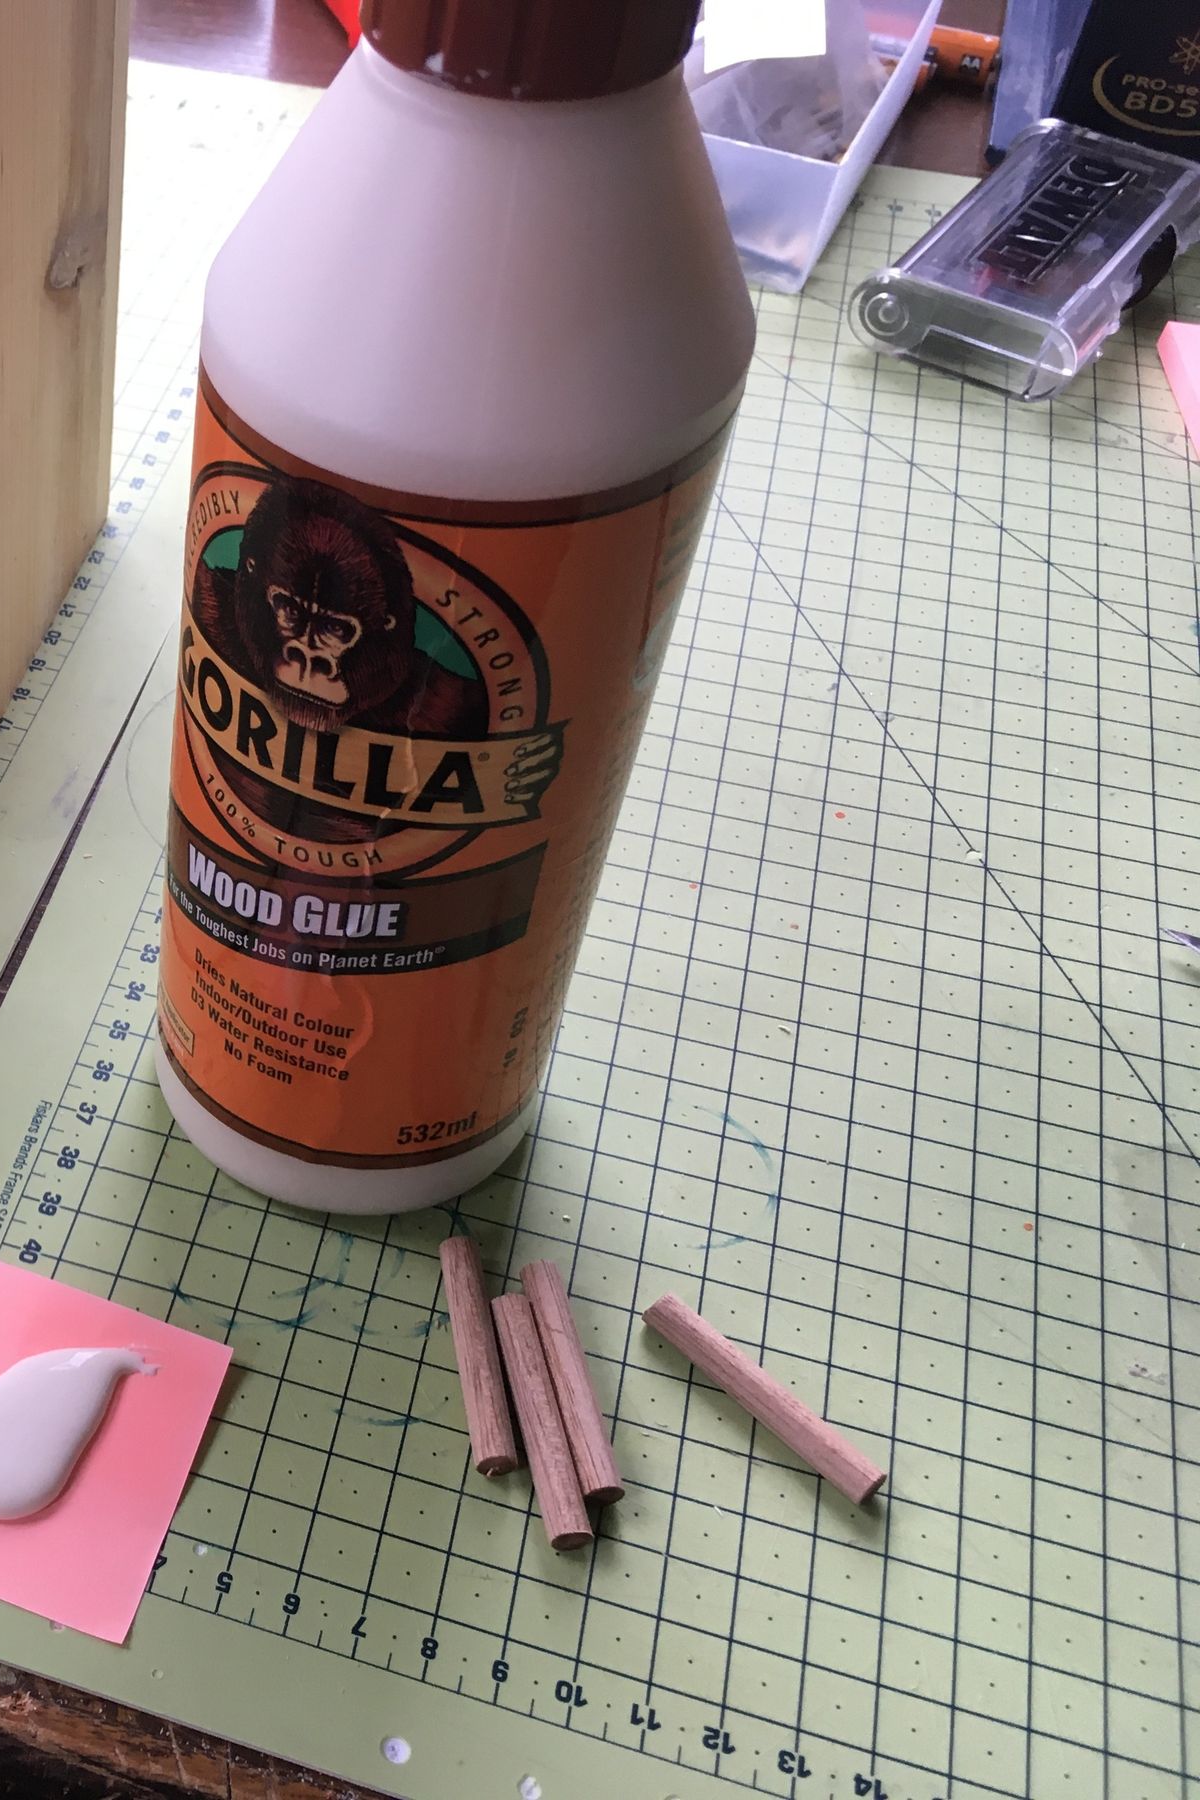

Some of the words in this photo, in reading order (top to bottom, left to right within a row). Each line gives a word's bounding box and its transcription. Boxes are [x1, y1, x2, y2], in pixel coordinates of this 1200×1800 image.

[962, 56, 980, 69] AA
[88, 550, 104, 564] 23
[74, 576, 91, 590] 22
[59, 603, 76, 617] 21
[44, 630, 62, 645] 20
[29, 658, 46, 672] 19
[436, 589, 524, 721] STRONG
[12, 688, 30, 702] 18
[206, 774, 256, 838] 100%
[273, 837, 383, 868] TOUGH
[189, 843, 283, 926] WOOD
[293, 895, 401, 938] GLUE
[180, 891, 192, 914] the
[196, 904, 249, 949] Toughest
[252, 938, 286, 960] Jobs
[292, 950, 312, 965] on
[319, 953, 377, 969] Planet
[140, 944, 160, 964] 33
[124, 981, 146, 1002] 34
[195, 948, 226, 986] Dries
[230, 979, 288, 1021] Natural
[293, 1012, 354, 1039] Colour
[196, 971, 308, 1048] Indoor/Outdoor
[314, 1039, 346, 1059] Use
[108, 1020, 130, 1041] 35
[191, 986, 204, 1010] D3
[208, 1004, 249, 1043] Water
[254, 1037, 350, 1081] Resistance
[92, 1060, 114, 1082] 36
[224, 1038, 242, 1060] No
[247, 1054, 292, 1085] Foam
[28, 1100, 52, 1134] Fiskars
[76, 1102, 98, 1126] 37
[395, 1111, 478, 1146] 532ml
[13, 1135, 38, 1170] Brands
[57, 1146, 80, 1170] 38
[38, 1192, 62, 1216] 39
[18, 1238, 42, 1264] 40
[216, 1571, 234, 1594] 5
[283, 1593, 300, 1615] 6
[351, 1616, 368, 1638] 7
[420, 1638, 438, 1660] 8
[492, 1660, 510, 1682] 9
[555, 1680, 588, 1707] 10
[630, 1703, 662, 1730] 11
[702, 1726, 736, 1755] 12
[778, 1750, 812, 1778] 13
[854, 1773, 888, 1800] 14
